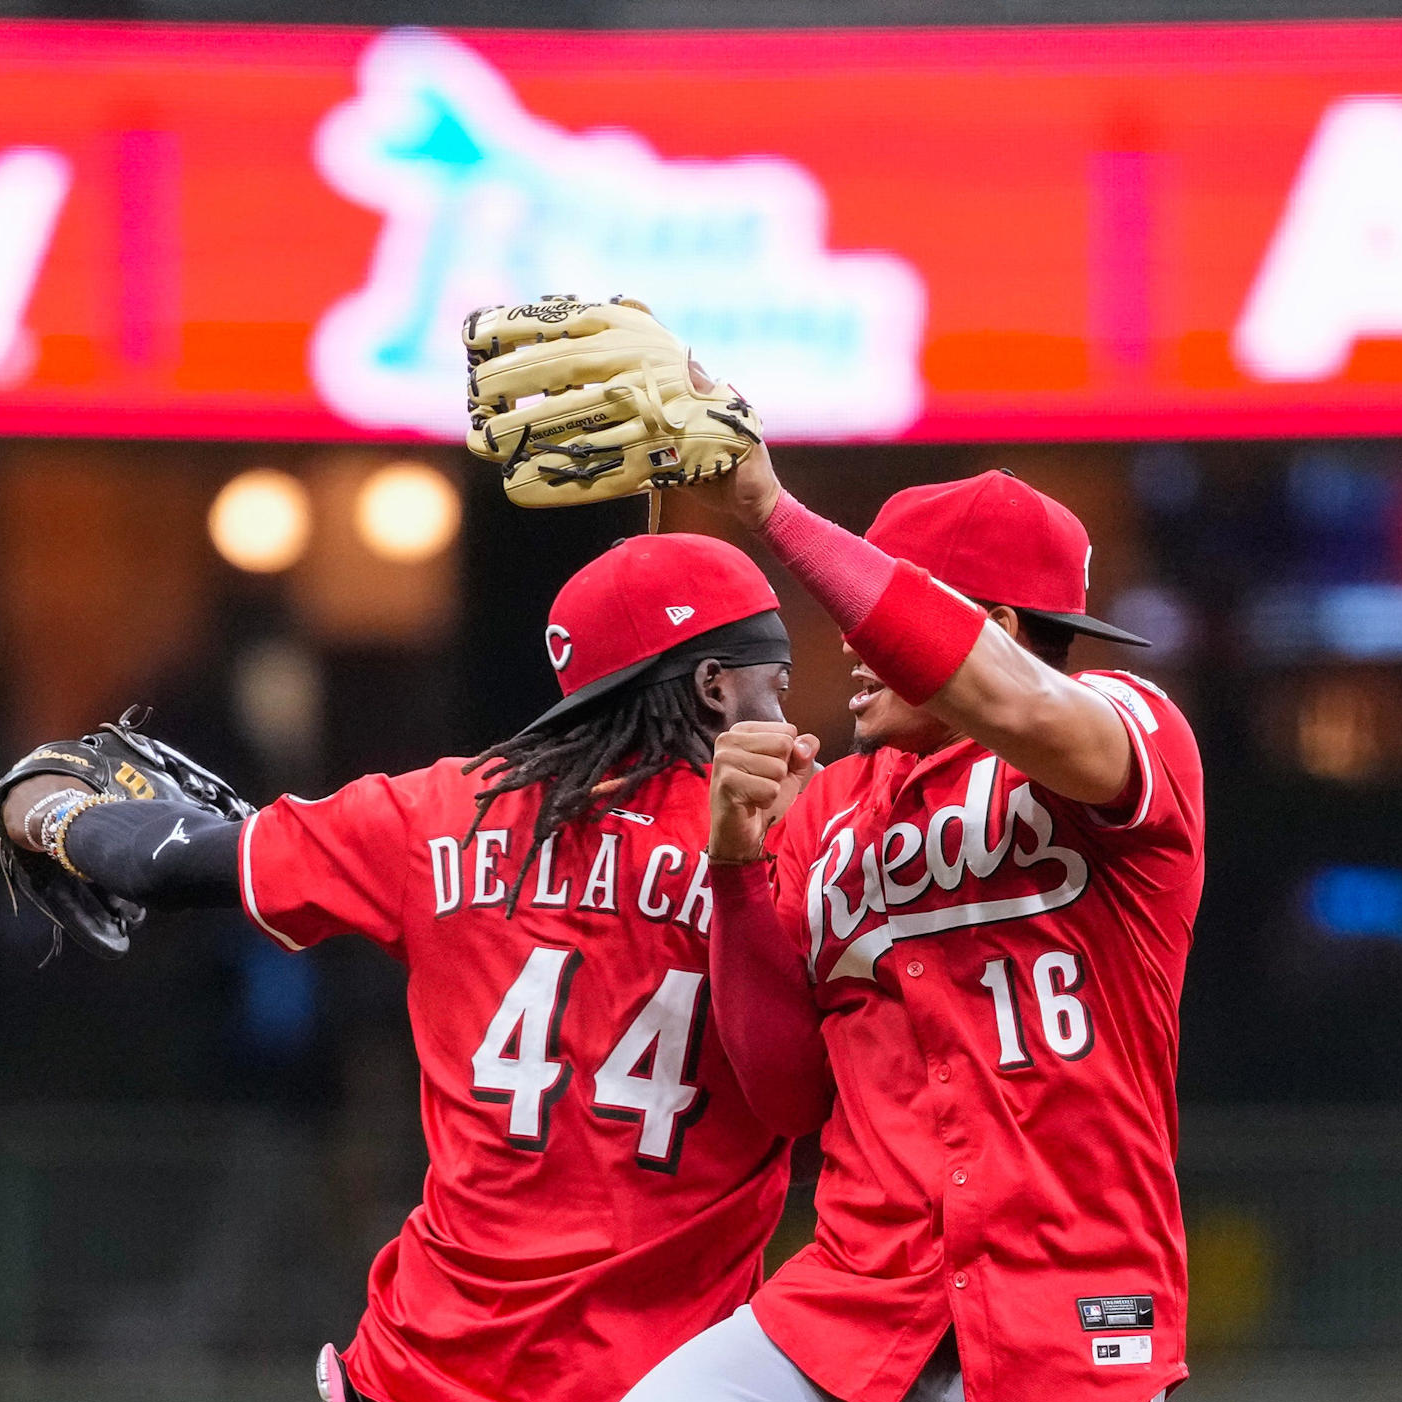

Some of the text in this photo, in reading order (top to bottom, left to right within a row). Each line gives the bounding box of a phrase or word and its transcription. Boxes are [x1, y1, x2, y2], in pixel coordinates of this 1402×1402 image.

[545, 624, 572, 671] C
[427, 828, 510, 919] DE
[529, 829, 623, 915] LA
[807, 755, 1090, 983] Reds
[471, 945, 718, 1174] 44
[979, 950, 1096, 1070] 16
